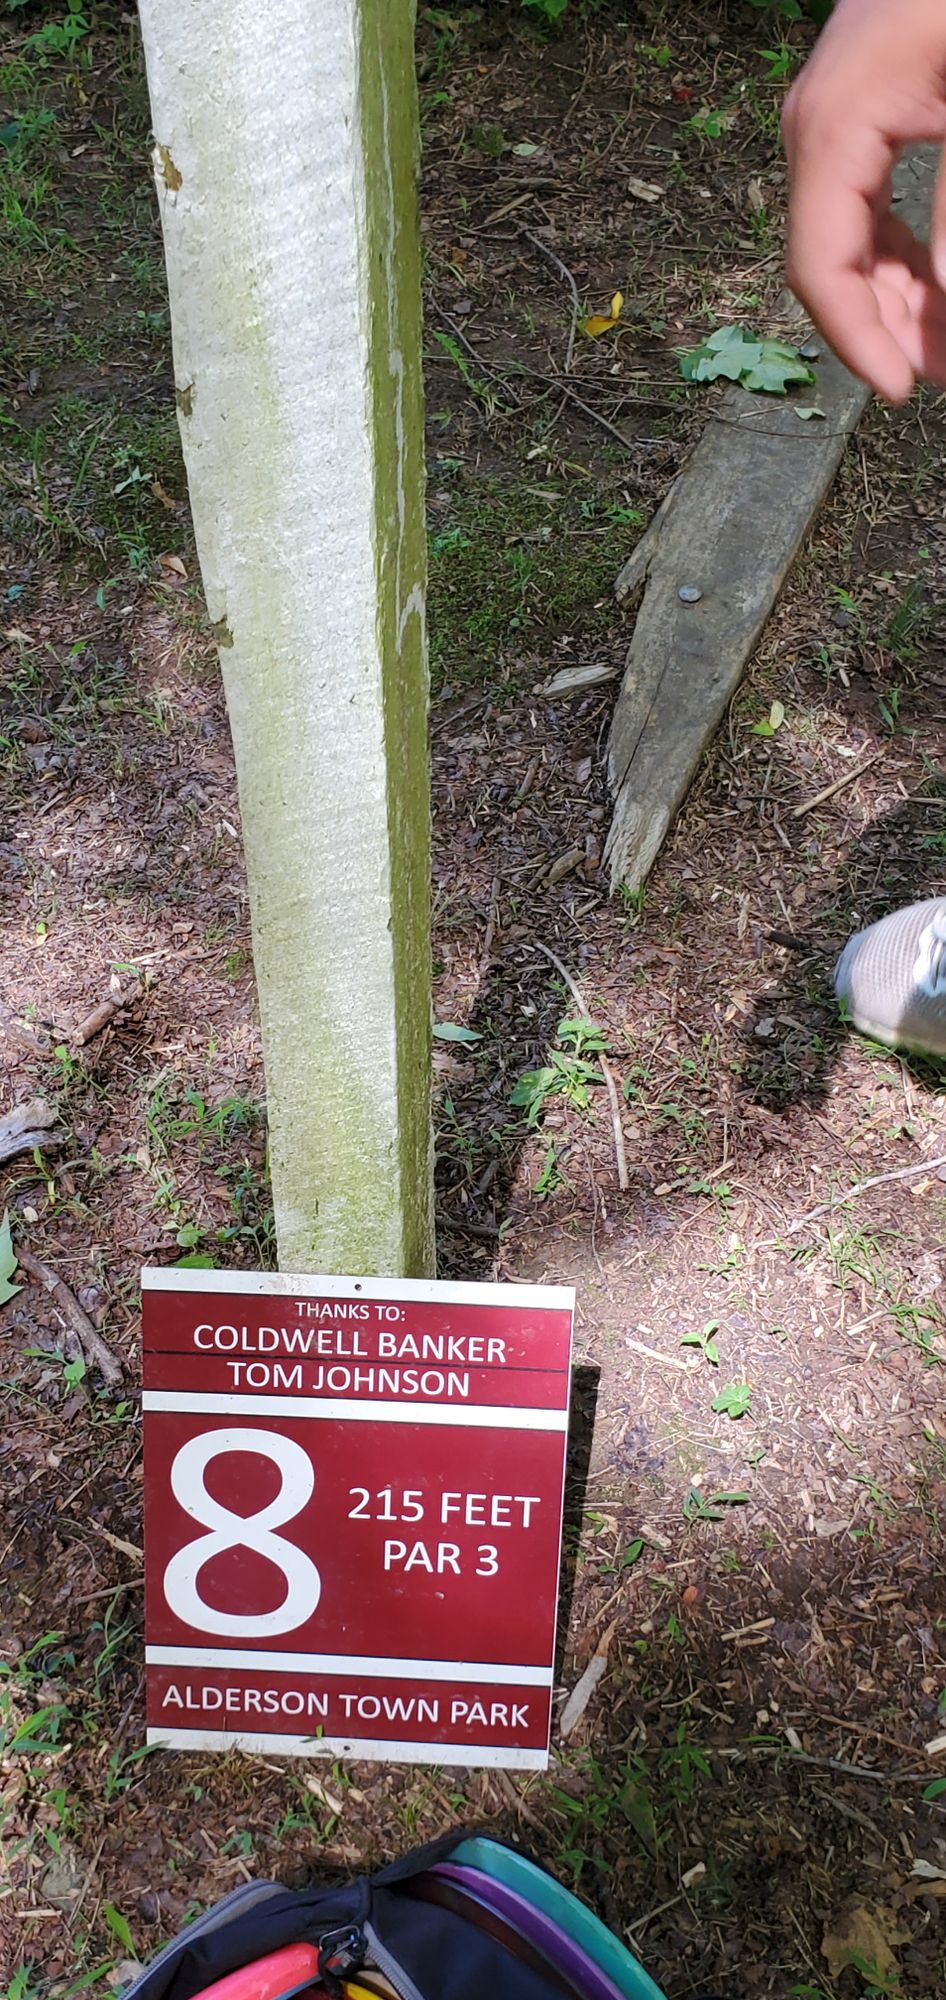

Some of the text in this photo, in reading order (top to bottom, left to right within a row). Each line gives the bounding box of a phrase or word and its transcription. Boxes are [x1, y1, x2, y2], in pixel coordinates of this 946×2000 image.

[295, 1302, 406, 1322] THANKS TO:
[194, 1325, 506, 1363] COLDWELL BANKER
[227, 1362, 469, 1397] TOM JOHNSON
[348, 1488, 541, 1528] 215 FEET
[164, 1428, 321, 1638] 8
[384, 1540, 498, 1576] PAR 3
[162, 1685, 529, 1727] ALDERSON TOWN PARK
